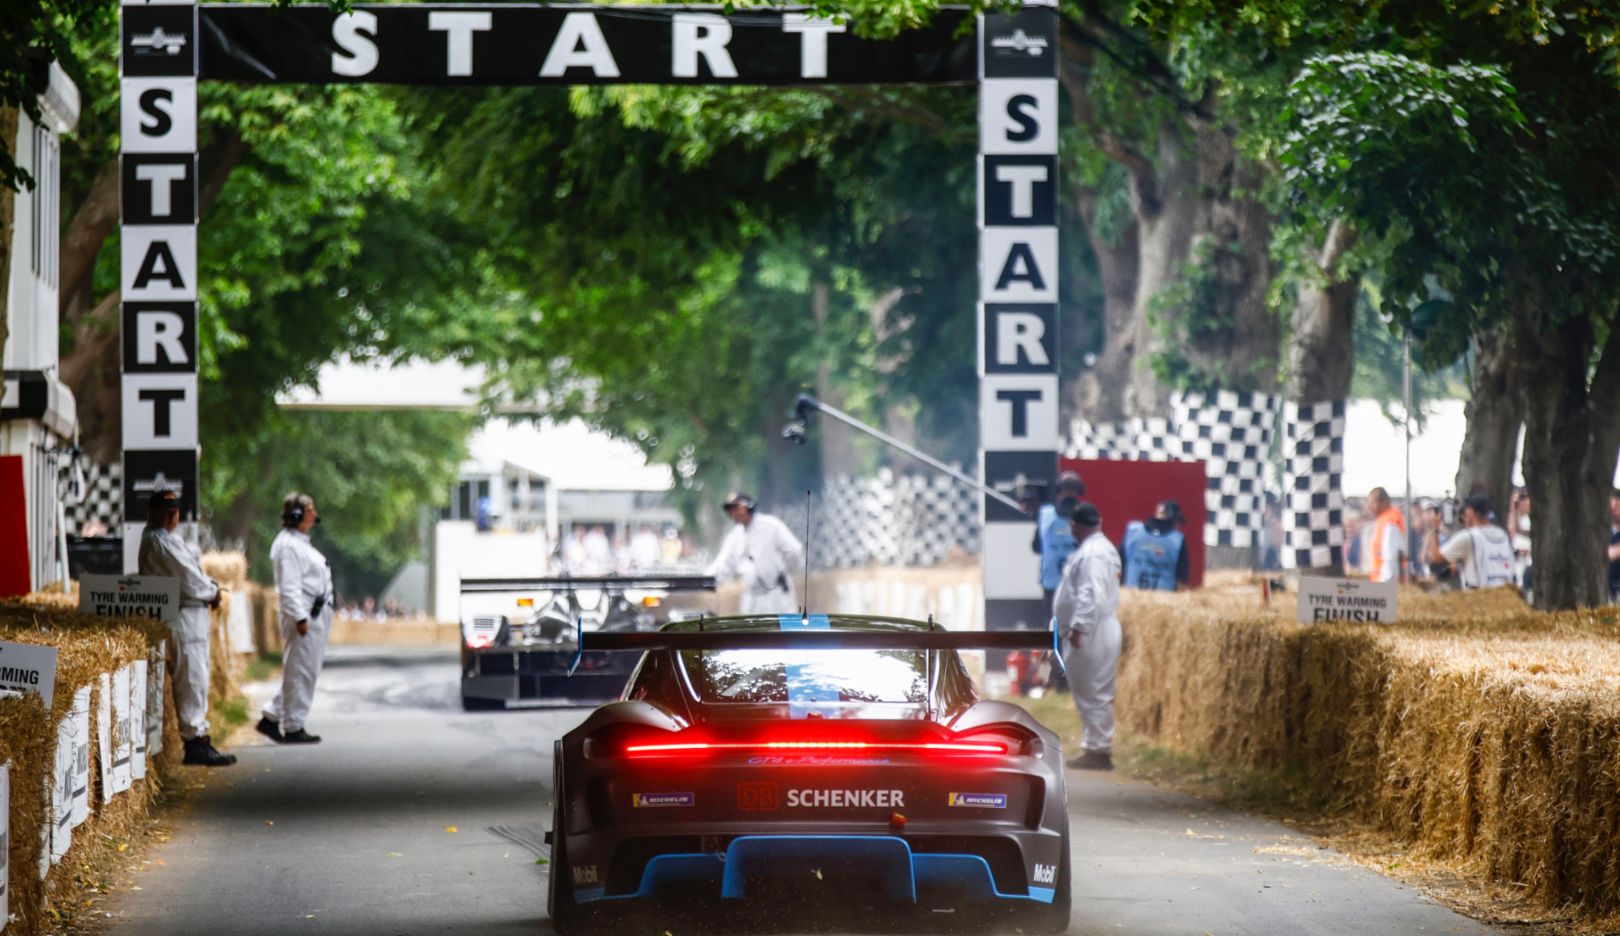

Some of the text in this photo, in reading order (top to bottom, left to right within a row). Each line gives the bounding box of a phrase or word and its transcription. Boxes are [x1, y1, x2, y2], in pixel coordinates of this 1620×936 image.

[331, 11, 847, 77] START
[132, 88, 188, 438] START
[995, 94, 1049, 437] START
[90, 591, 169, 604] TYRE WARMING
[1308, 594, 1387, 609] TYRE WARMING
[1313, 607, 1380, 625] FINISH
[0, 666, 39, 685] MING
[787, 789, 905, 807] SCHENKER
[966, 797, 1003, 805] MICHELIN
[1033, 863, 1057, 883] Mobil
